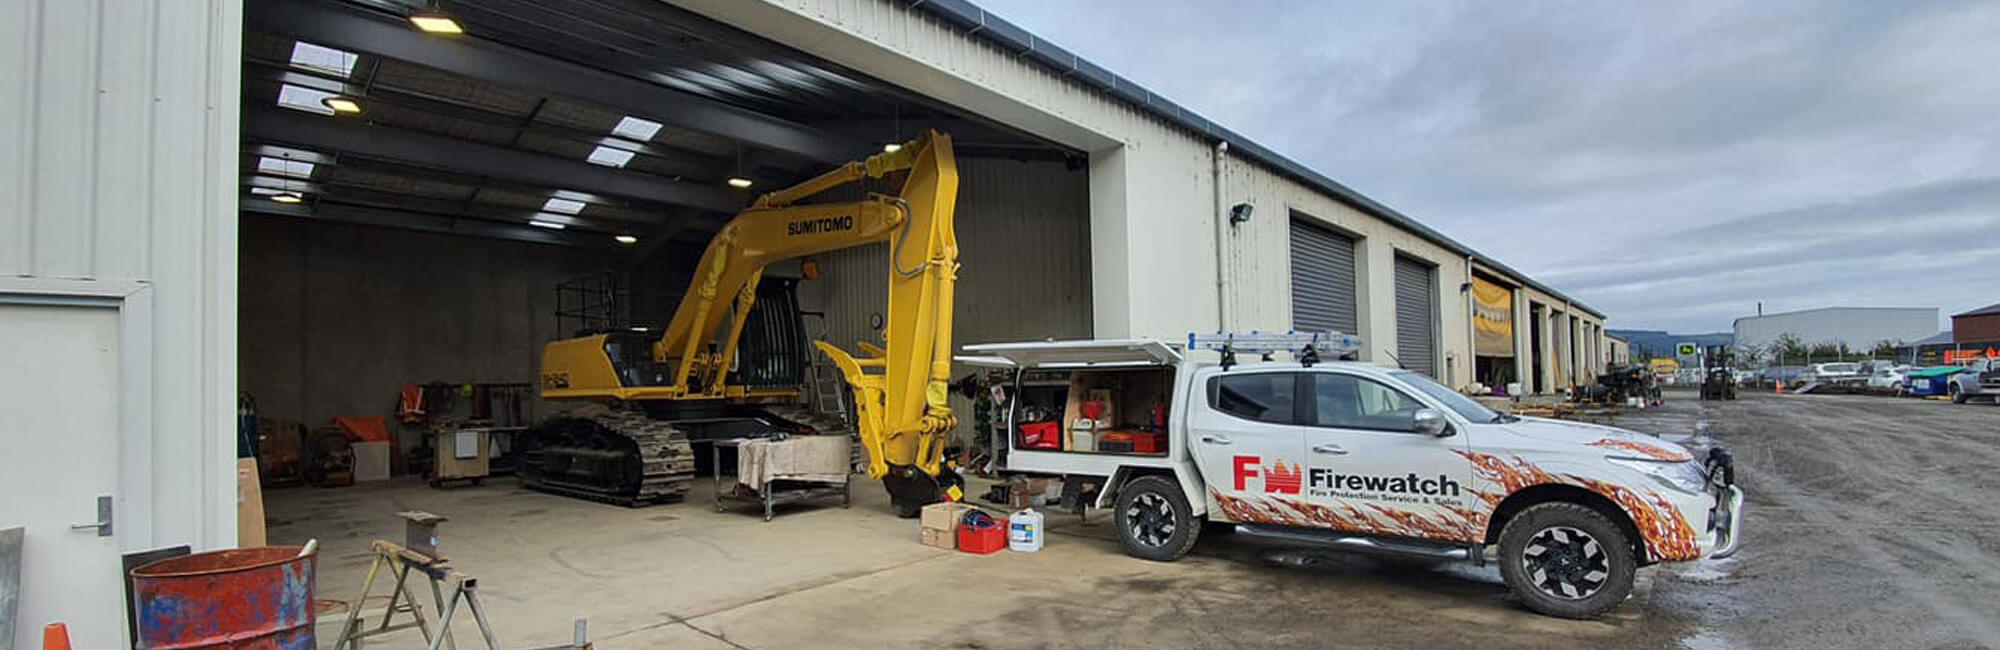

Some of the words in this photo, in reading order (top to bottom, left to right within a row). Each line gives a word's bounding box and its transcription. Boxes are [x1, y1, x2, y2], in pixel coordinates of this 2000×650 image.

[787, 215, 853, 236] SUMITOMO
[1309, 467, 1460, 497] Firewatch
[1310, 489, 1327, 497] Fire
[1330, 490, 1378, 501] Protection
[1382, 494, 1418, 504] Service
[1423, 496, 1430, 504] &
[1434, 497, 1463, 506] Sales
